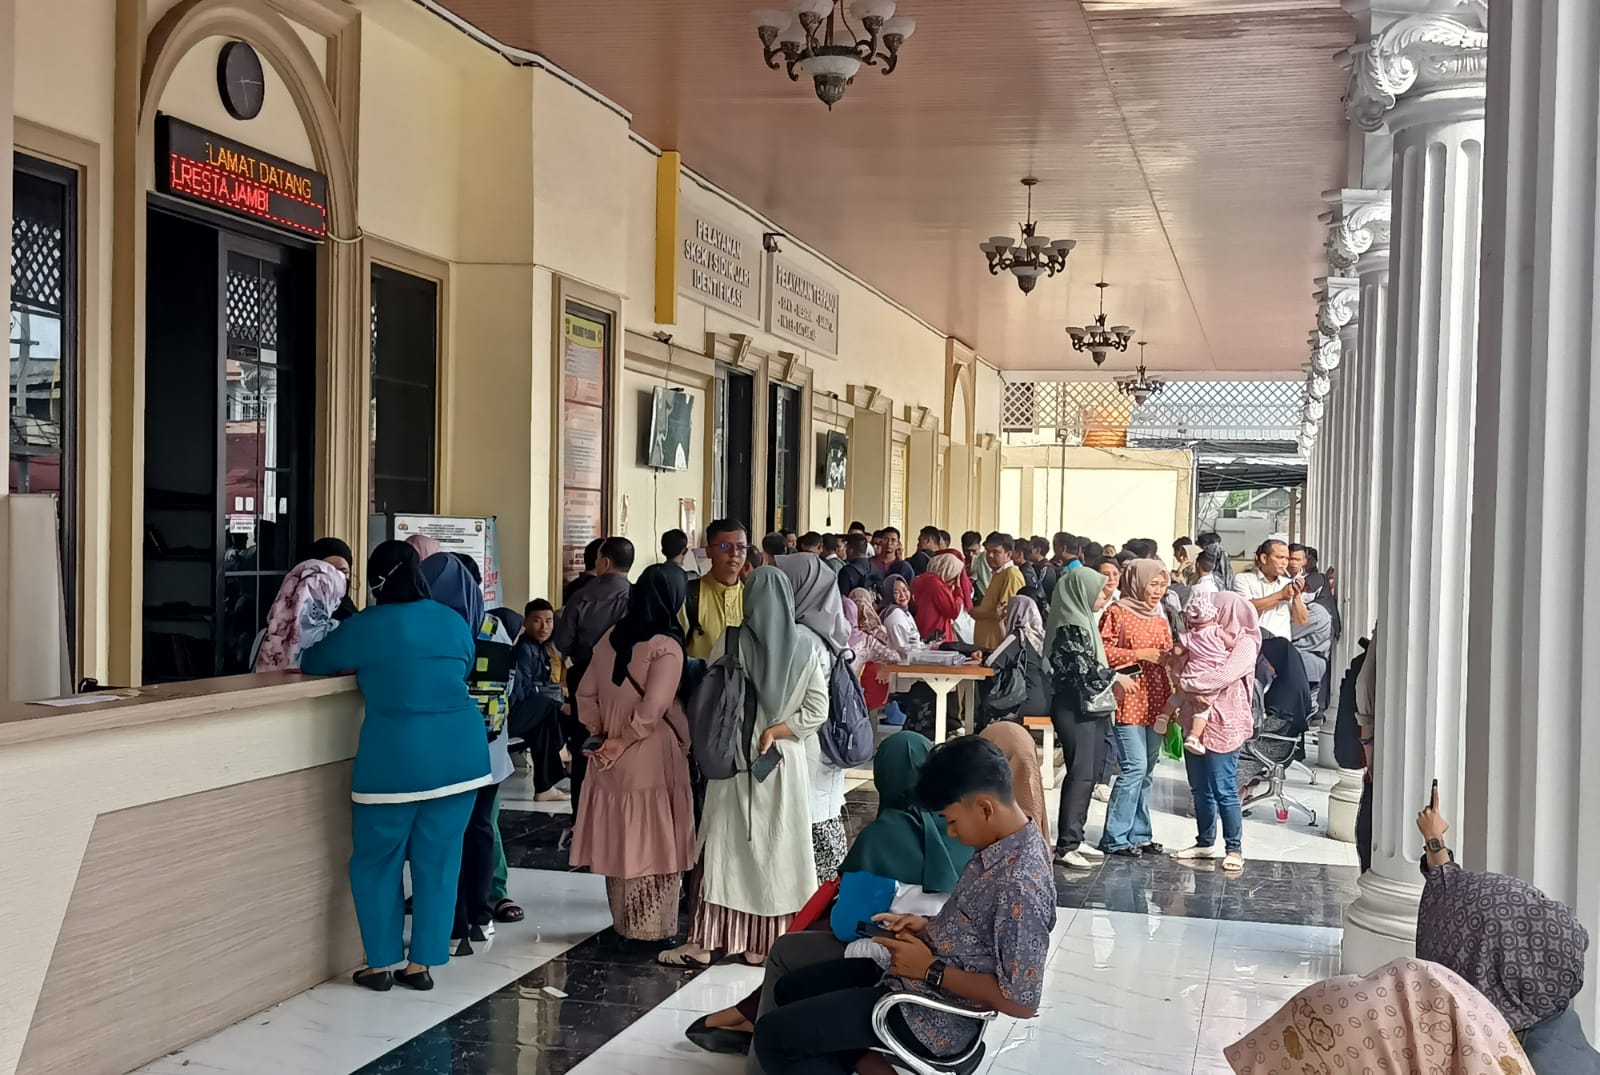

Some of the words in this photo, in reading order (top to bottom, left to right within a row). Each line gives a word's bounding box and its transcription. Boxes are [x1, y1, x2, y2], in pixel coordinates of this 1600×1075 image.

[205, 142, 256, 178] LAMAT
[259, 162, 312, 199] DATANG
[231, 182, 270, 212] JAMBI
[696, 218, 742, 260] PELAYANAN
[711, 253, 734, 281] SIDIK
[692, 269, 743, 309] IDENTIFIKASI
